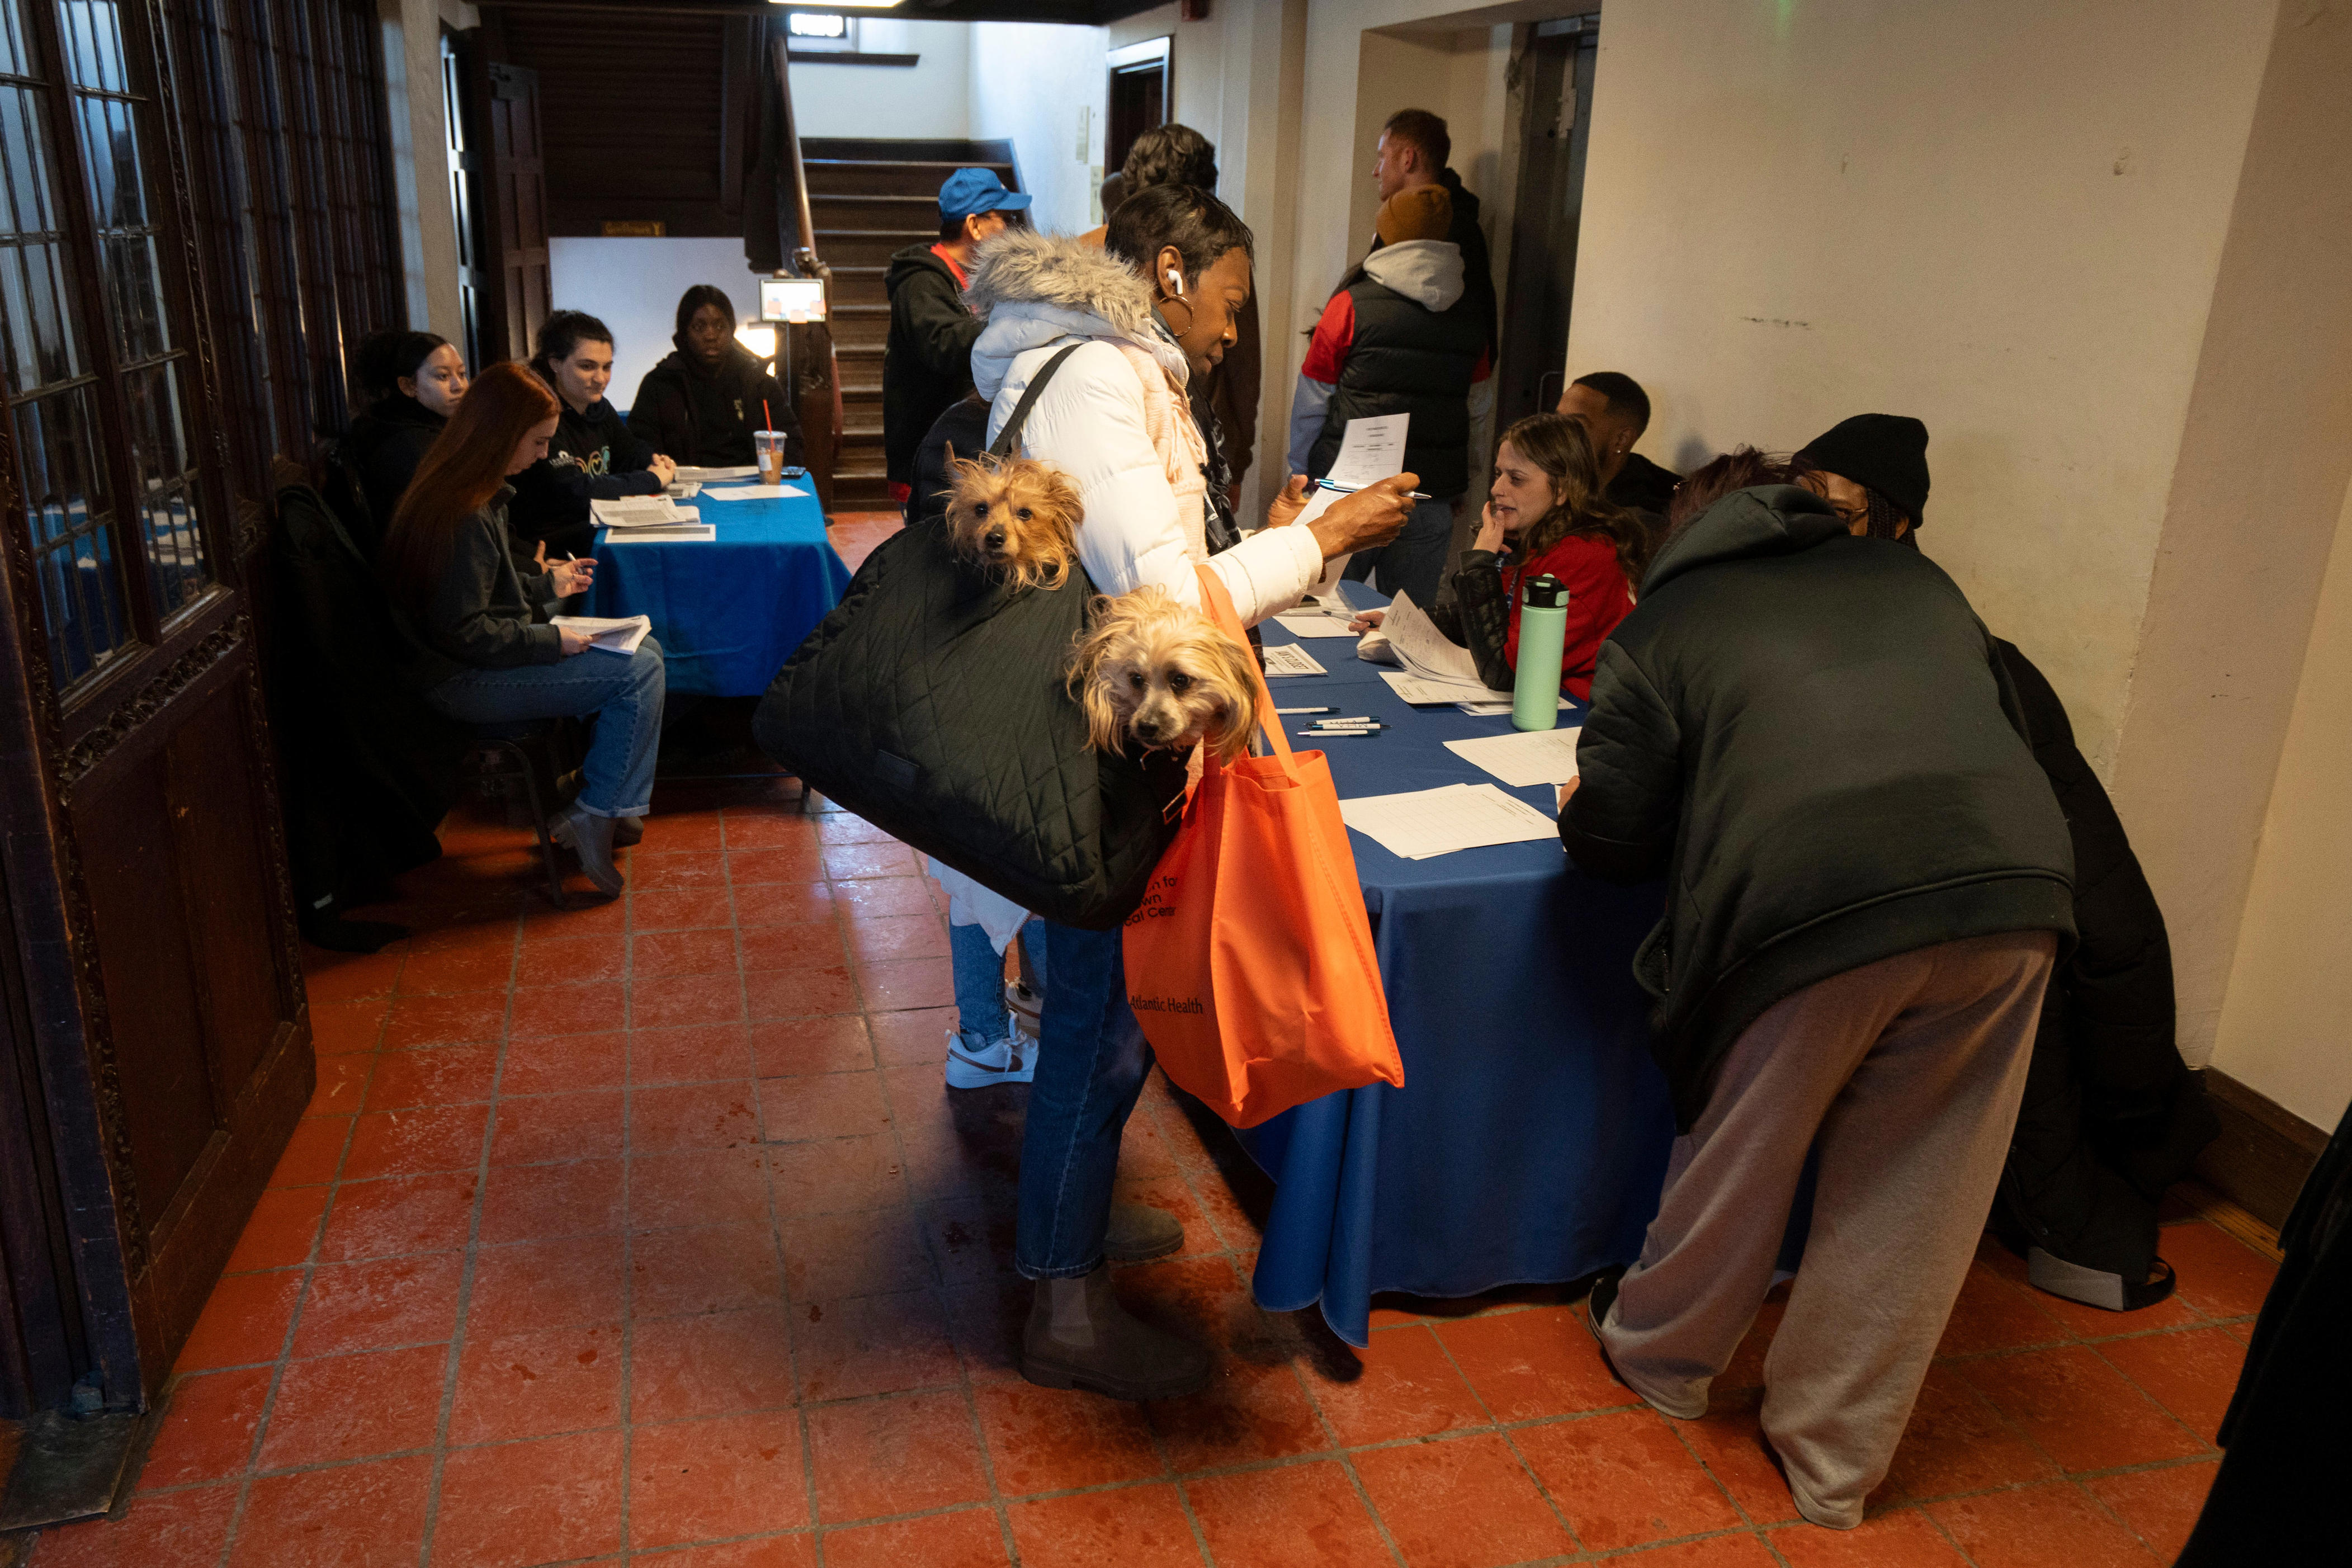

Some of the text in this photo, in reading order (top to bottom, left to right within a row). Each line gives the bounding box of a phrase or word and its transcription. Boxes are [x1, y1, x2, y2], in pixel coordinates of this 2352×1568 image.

[1123, 910, 1145, 927] cal
[1130, 995, 1203, 1014] Atlantic Health
